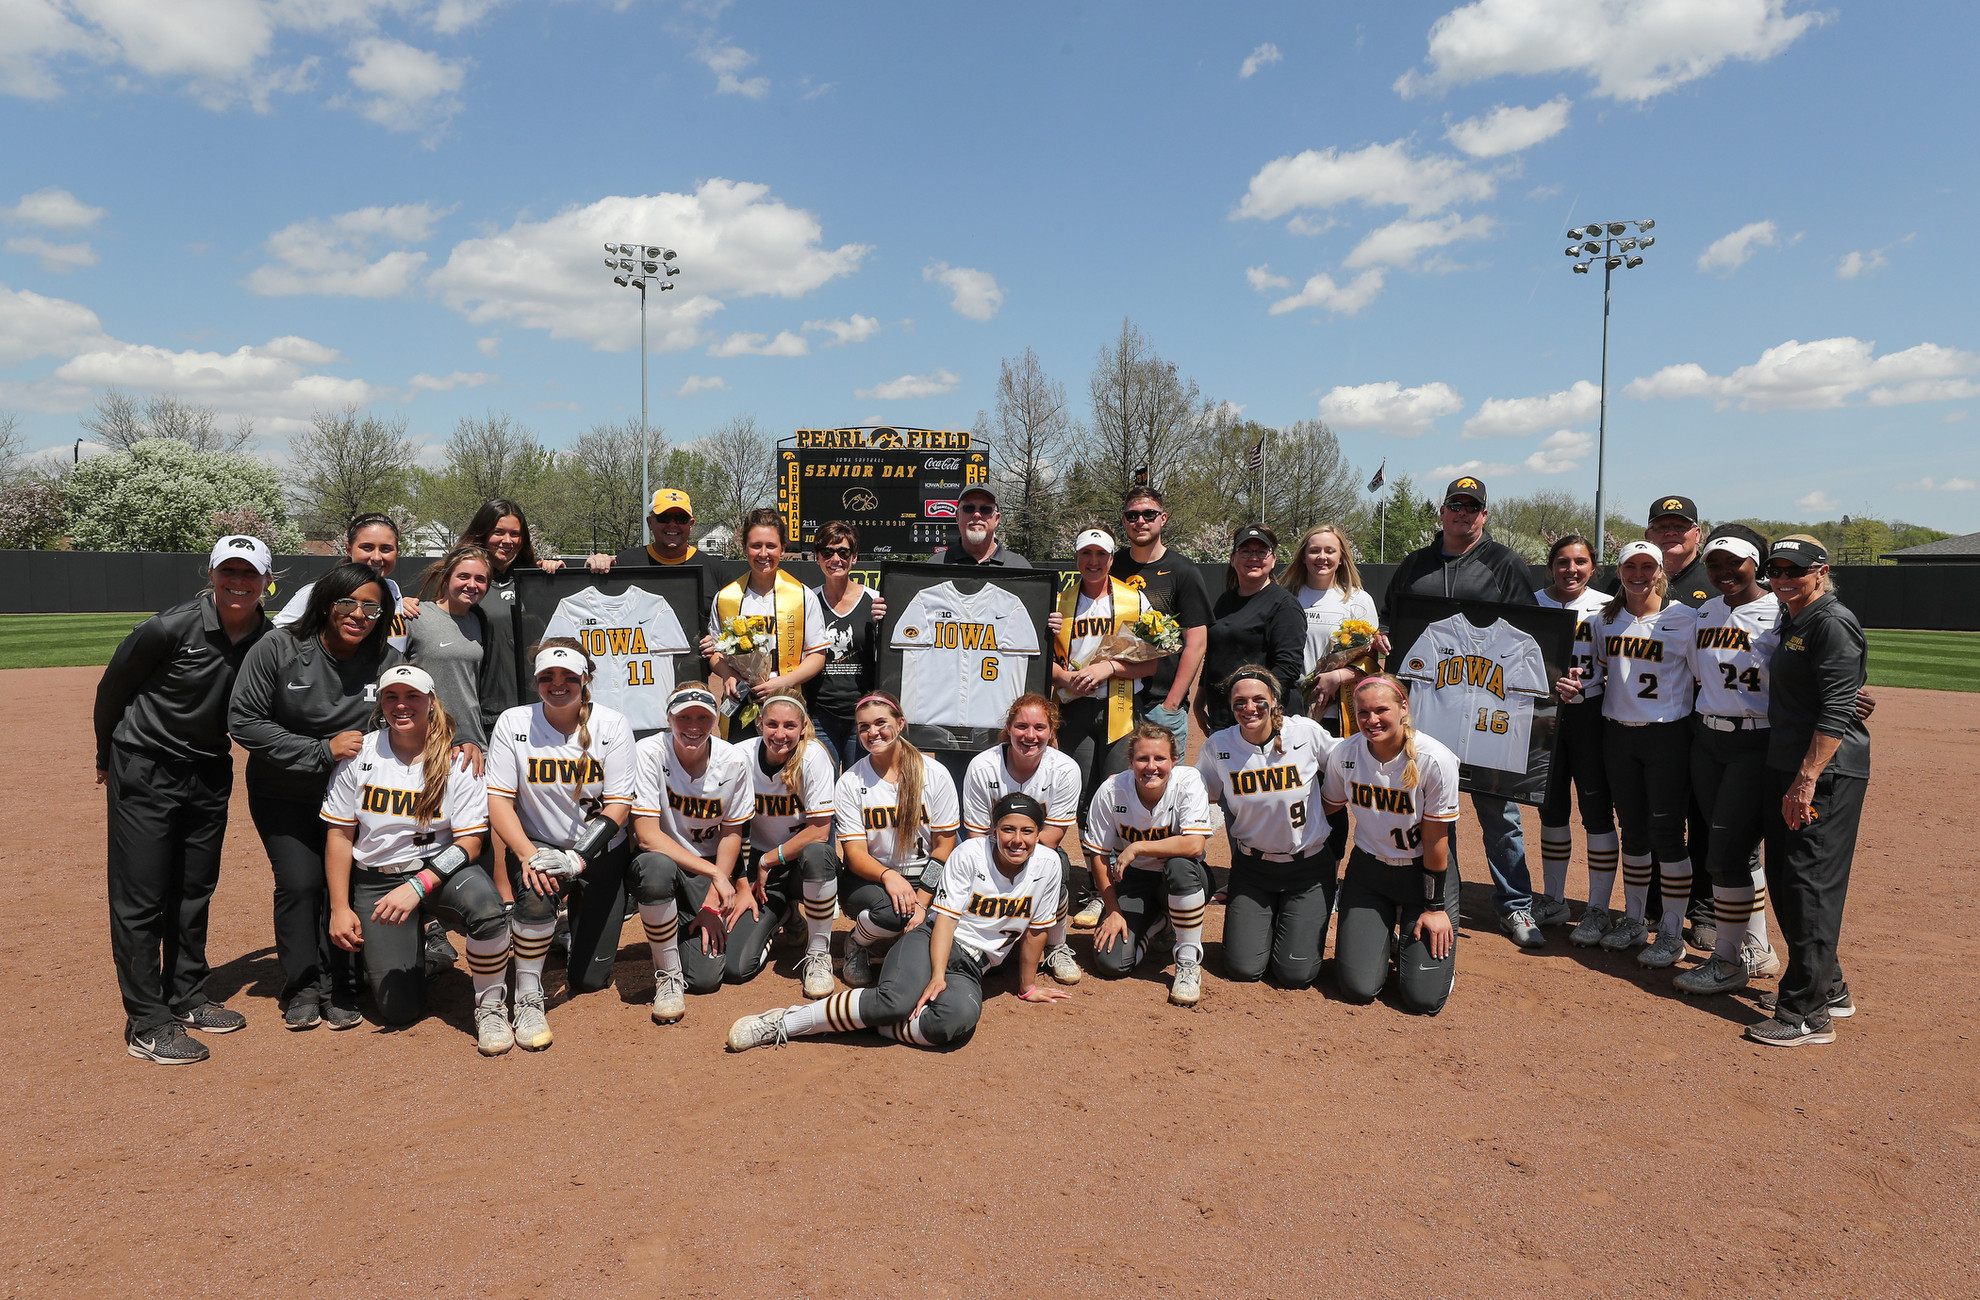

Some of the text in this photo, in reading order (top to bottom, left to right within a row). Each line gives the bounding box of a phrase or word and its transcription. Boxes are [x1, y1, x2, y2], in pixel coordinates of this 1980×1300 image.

[796, 430, 971, 449] PEARL FIELD
[805, 465, 917, 478] SENIOR DAY
[791, 465, 799, 539] SOFTBALL
[1773, 541, 1801, 551] IOWA
[580, 627, 648, 656] IOWA
[787, 614, 795, 658] STUDENT
[934, 621, 998, 651] IOWA
[1605, 635, 1664, 663] IOWA
[1697, 627, 1751, 652] IOWA
[627, 660, 654, 686] 11
[981, 656, 999, 681] 6
[1435, 655, 1505, 701] IOWA
[1718, 662, 1761, 692] 24
[1637, 672, 1658, 699] 2
[1475, 706, 1509, 734] 16
[527, 757, 604, 785] IOWA
[1229, 764, 1303, 796] IOWA
[755, 793, 805, 817] OWA
[1350, 781, 1415, 815] IOWA
[1289, 800, 1307, 829] 9
[1390, 822, 1421, 850] 16
[968, 892, 1033, 920] IOWA
[998, 930, 1021, 951] 7
